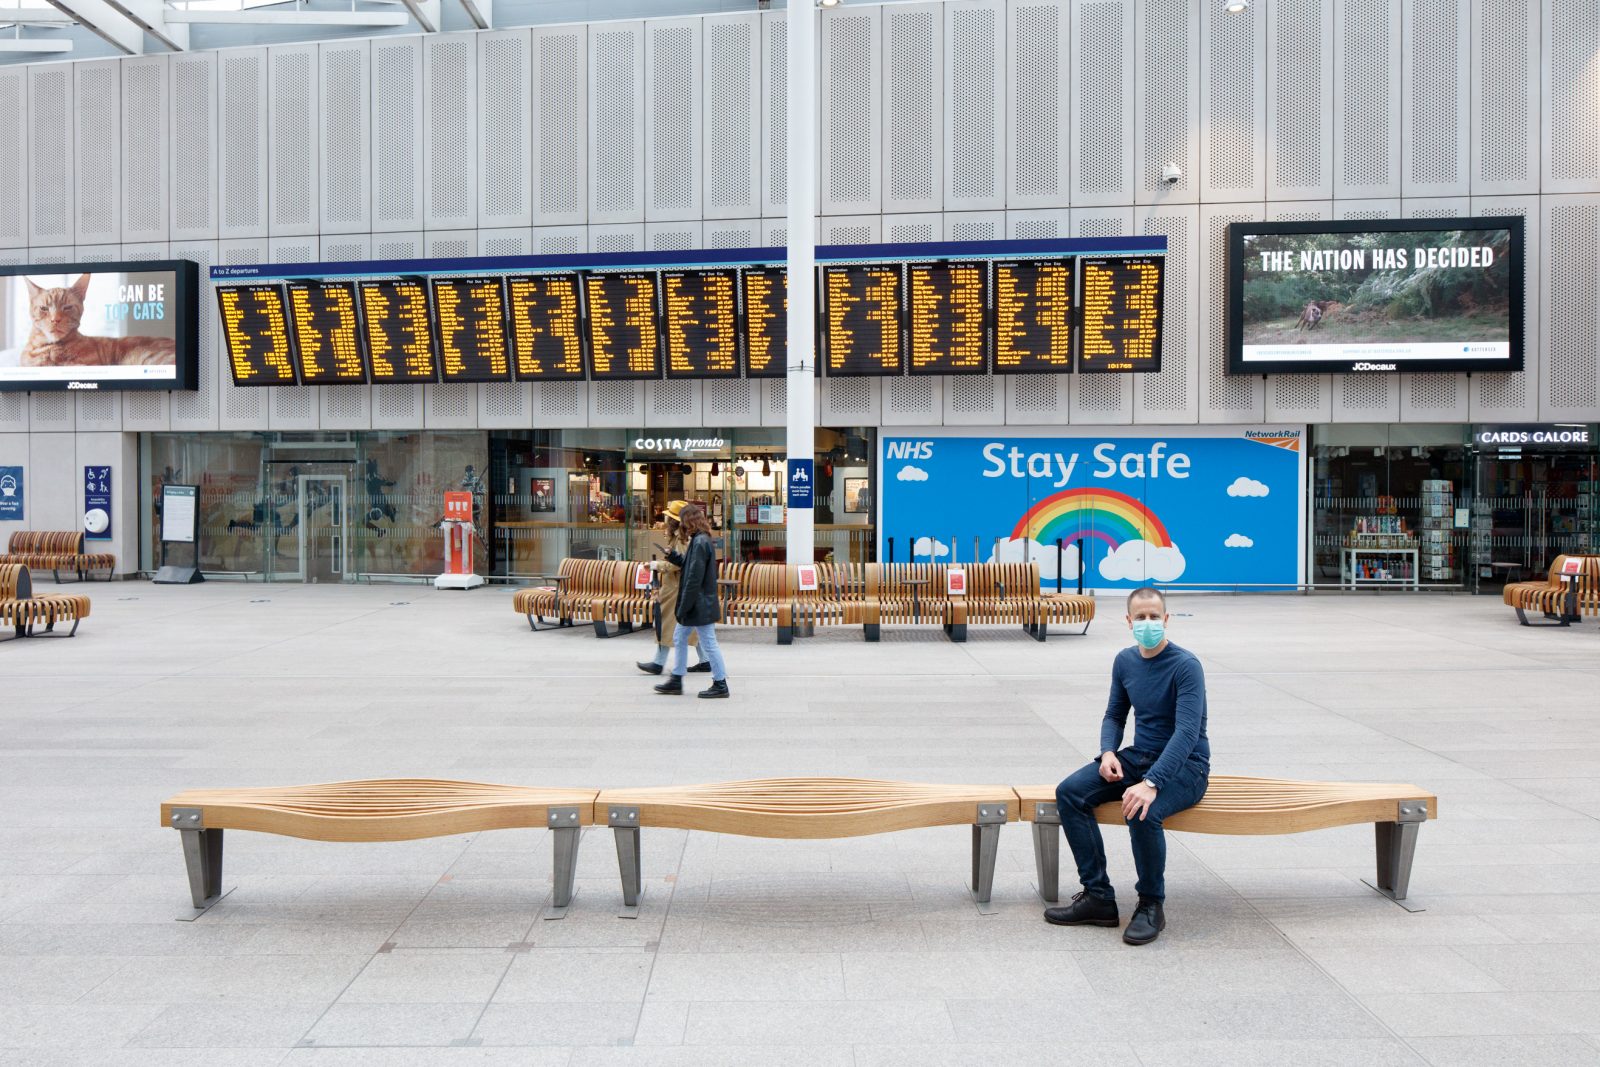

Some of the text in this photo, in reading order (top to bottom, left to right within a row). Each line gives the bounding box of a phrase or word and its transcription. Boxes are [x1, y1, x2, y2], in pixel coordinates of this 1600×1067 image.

[1260, 246, 1494, 272] THE NATION HAS DECIDED
[119, 284, 164, 302] CAN BE
[105, 302, 164, 320] TOP CATS
[1352, 362, 1396, 370] JCDecaux
[635, 438, 724, 452] COSTA pronto
[1481, 431, 1588, 442] CARDS GALORE
[886, 441, 934, 460] NHS
[982, 442, 1191, 488] Stay Safe
